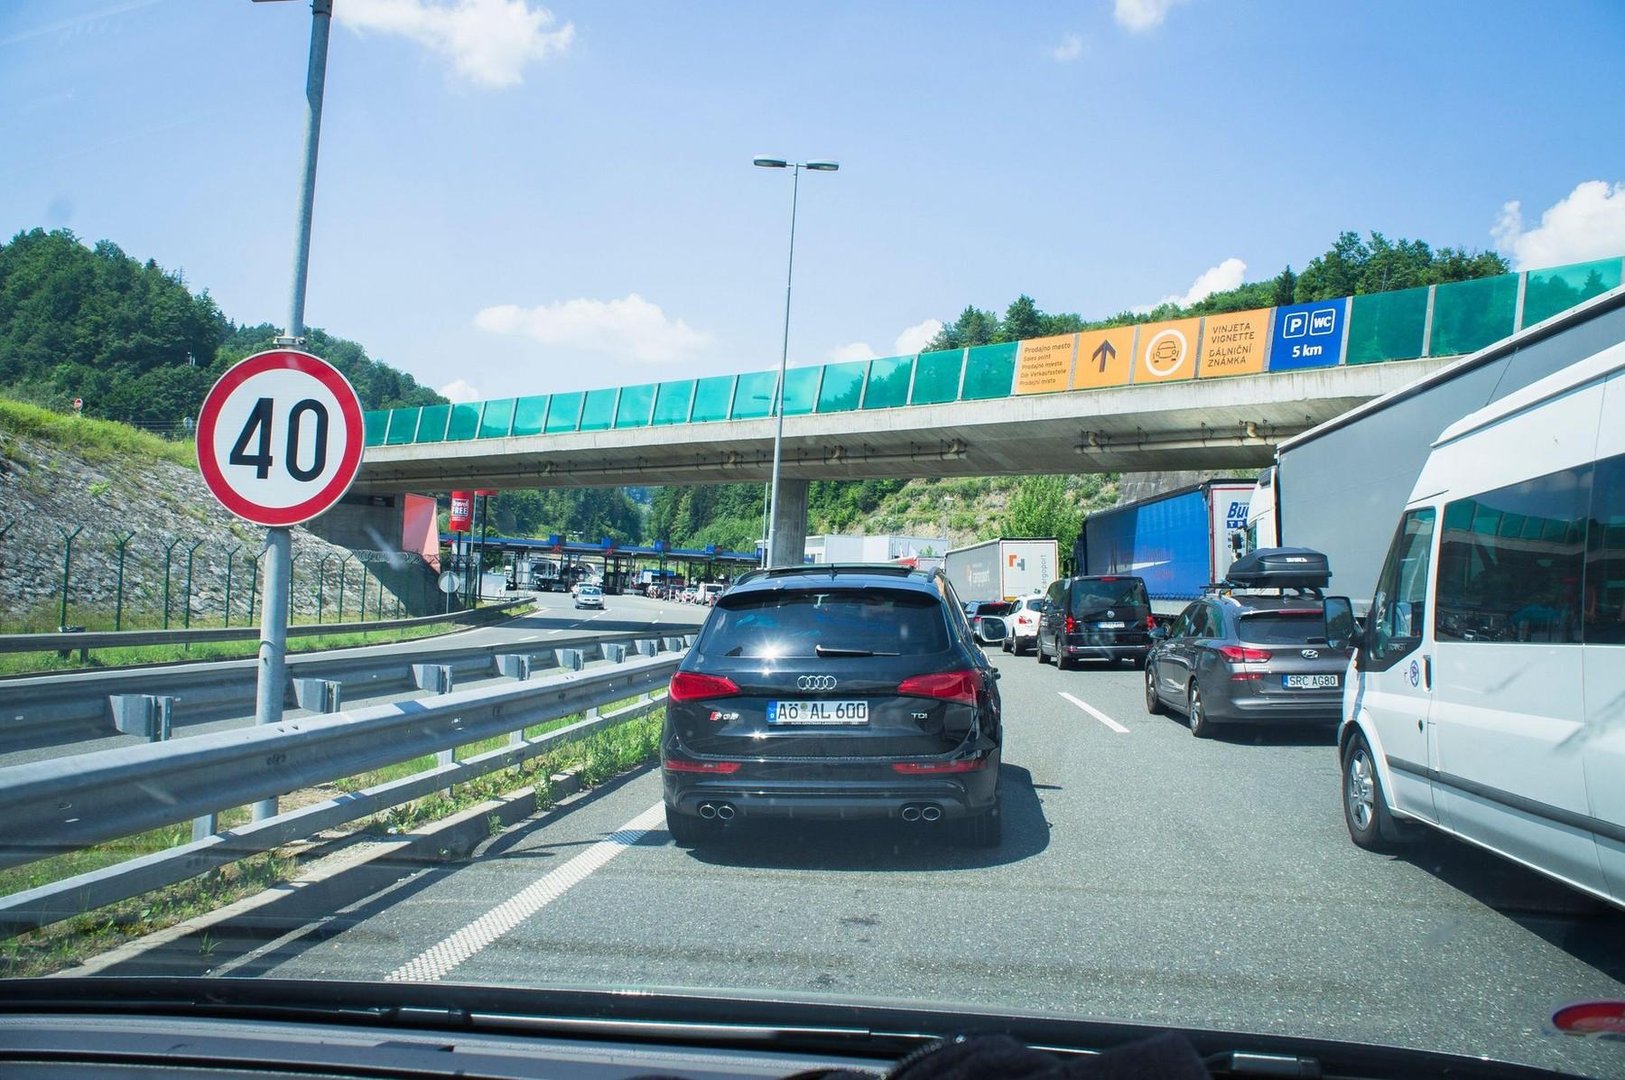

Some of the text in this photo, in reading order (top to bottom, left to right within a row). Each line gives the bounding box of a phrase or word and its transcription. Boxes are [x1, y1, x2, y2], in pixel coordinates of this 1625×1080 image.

[1212, 322, 1251, 334] VINJETA
[1290, 316, 1332, 333] P WC
[1211, 331, 1255, 344] VIGNETTE
[1292, 344, 1323, 358] 5 km
[1208, 355, 1246, 367] ZNÁMKA
[229, 397, 329, 482] 40
[1227, 502, 1249, 518] Bu
[1290, 675, 1336, 686] SRC AG80
[810, 703, 831, 719] AL
[836, 703, 866, 719] 600
